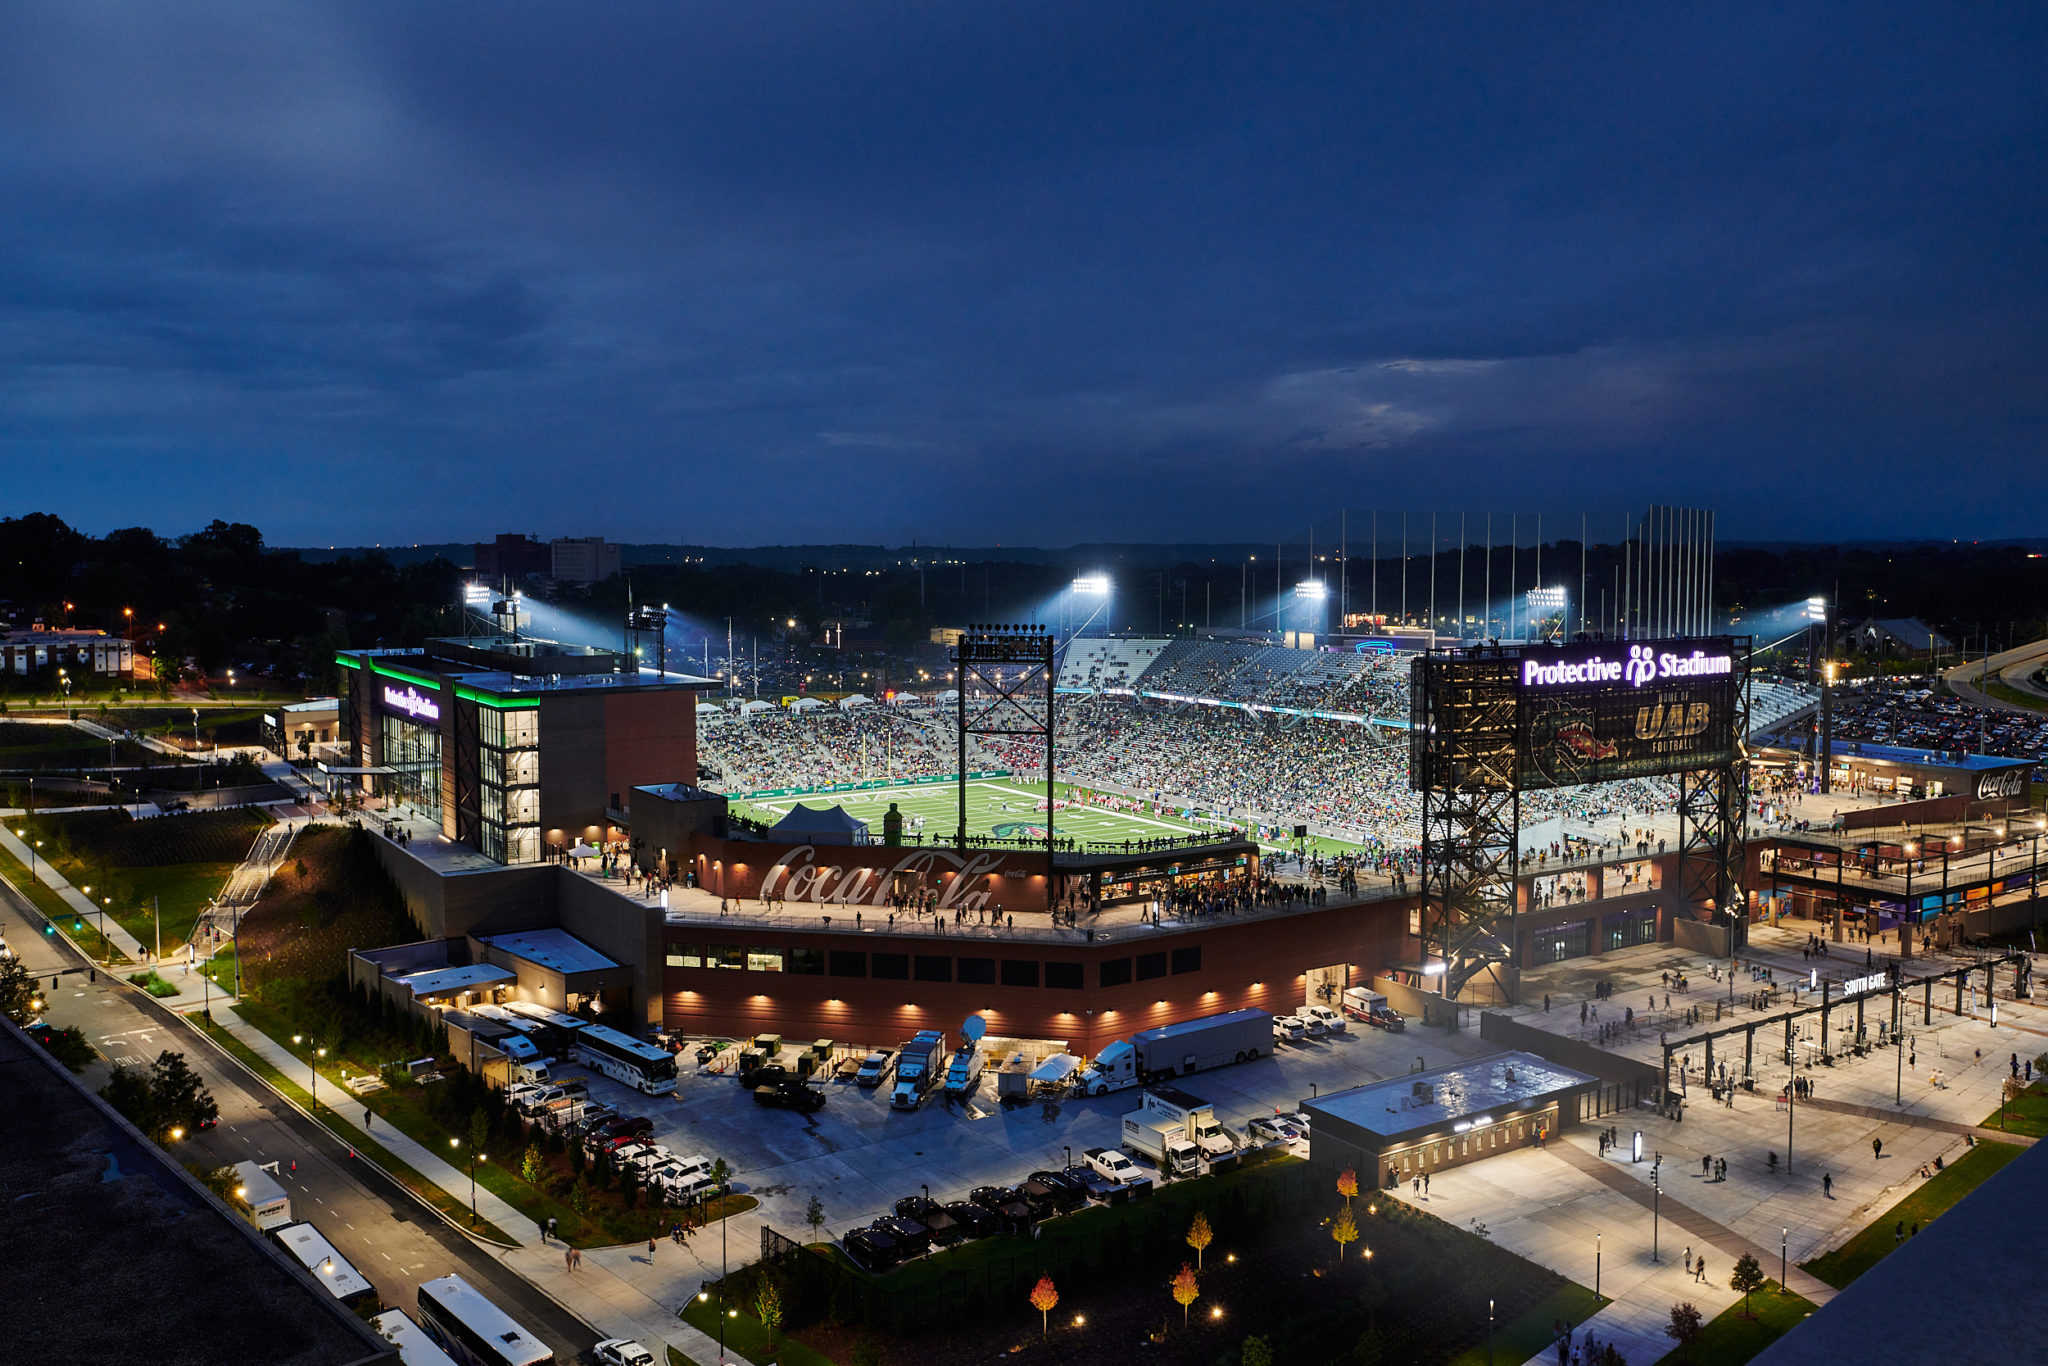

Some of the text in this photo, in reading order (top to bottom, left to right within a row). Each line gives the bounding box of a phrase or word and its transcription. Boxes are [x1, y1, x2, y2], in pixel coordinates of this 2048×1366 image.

[1524, 651, 1732, 686] Protective Stadium
[1658, 692, 1690, 702] HOME OF
[1634, 702, 1710, 740] UAB
[1652, 738, 1693, 753] FOOTBALL
[1977, 769, 2024, 800] Coca-Cola
[1844, 972, 1887, 996] SOUTH GATE
[115, 1055, 146, 1067] ONLY
[1125, 1119, 1140, 1129] METRO
